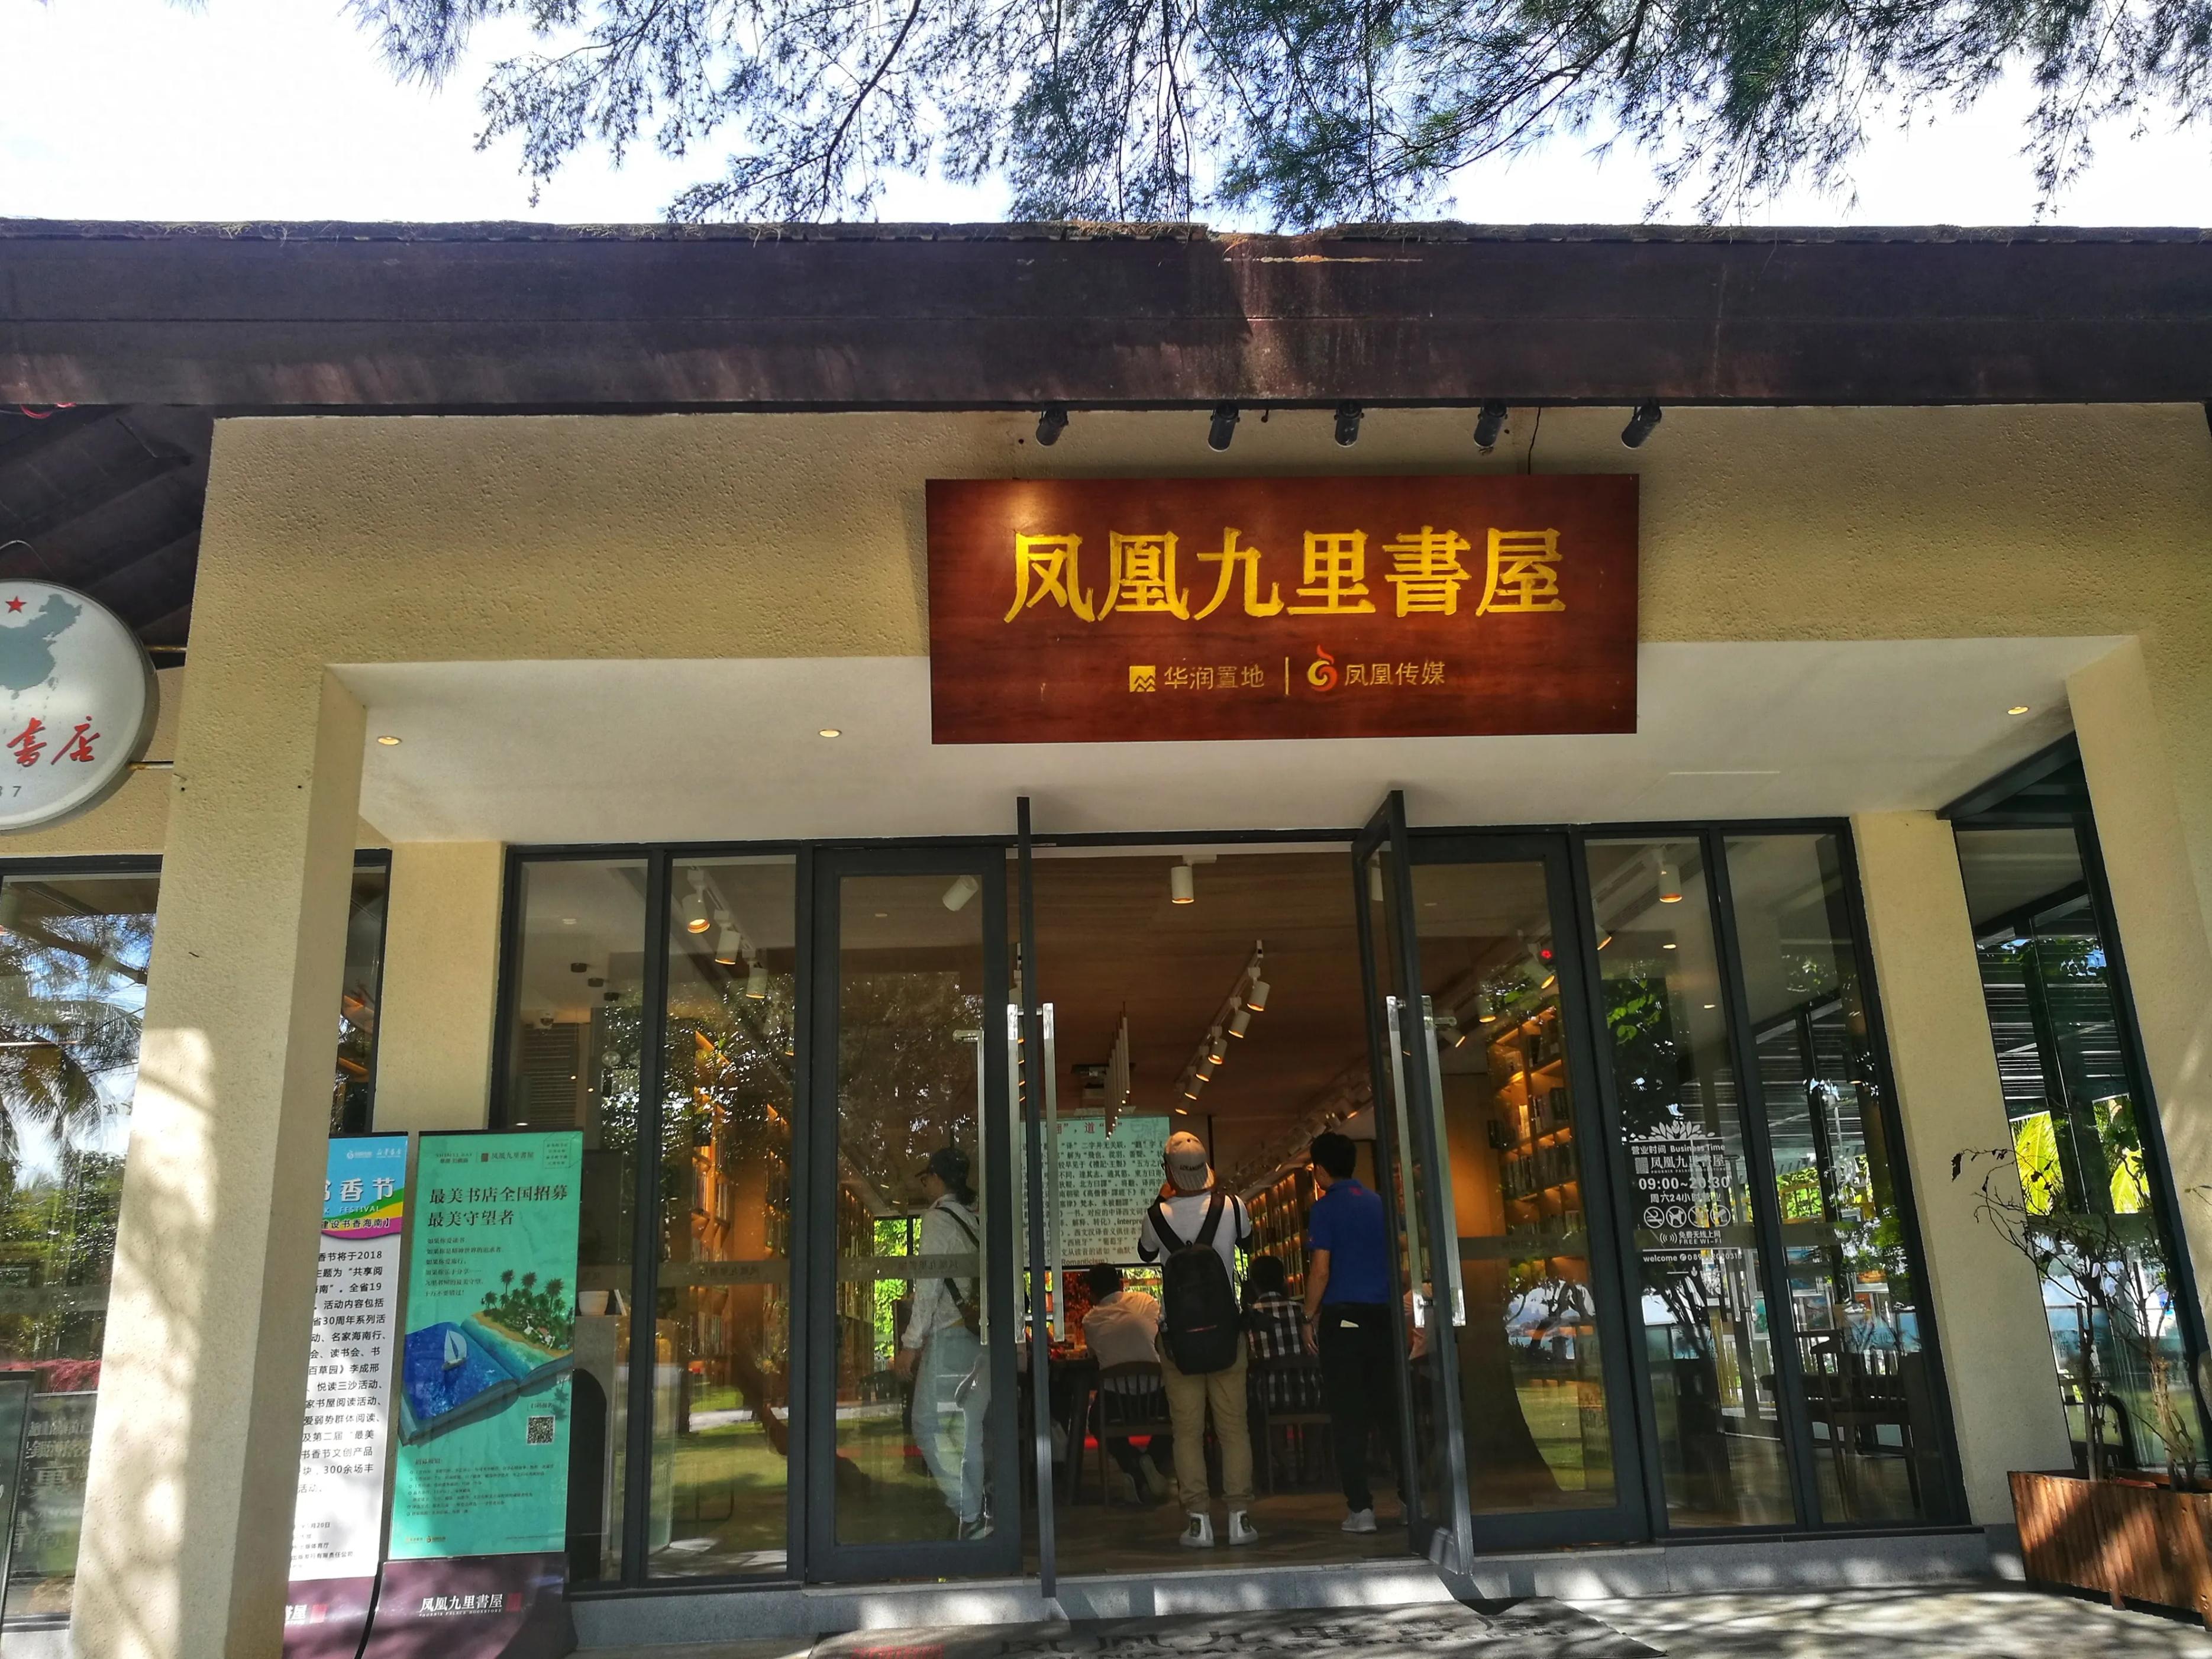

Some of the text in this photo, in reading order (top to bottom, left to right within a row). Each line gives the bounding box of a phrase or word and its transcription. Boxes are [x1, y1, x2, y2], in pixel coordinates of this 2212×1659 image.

[1004, 524, 1566, 622] 凤凰九里書屋
[1164, 661, 1445, 690] 华润置地 凤凰传媒
[1631, 1145, 1667, 1155] 营业时间
[429, 1184, 568, 1204] 最美书店全国招募
[428, 1210, 514, 1227] 最美守望者
[1678, 1230, 1721, 1239] 免费无线上网
[1643, 1254, 1678, 1263] welcome
[315, 1283, 382, 1293] 南”。全省19
[310, 1346, 380, 1358] 会、读书会、书
[419, 1593, 503, 1613] 凤凰九里書屋
